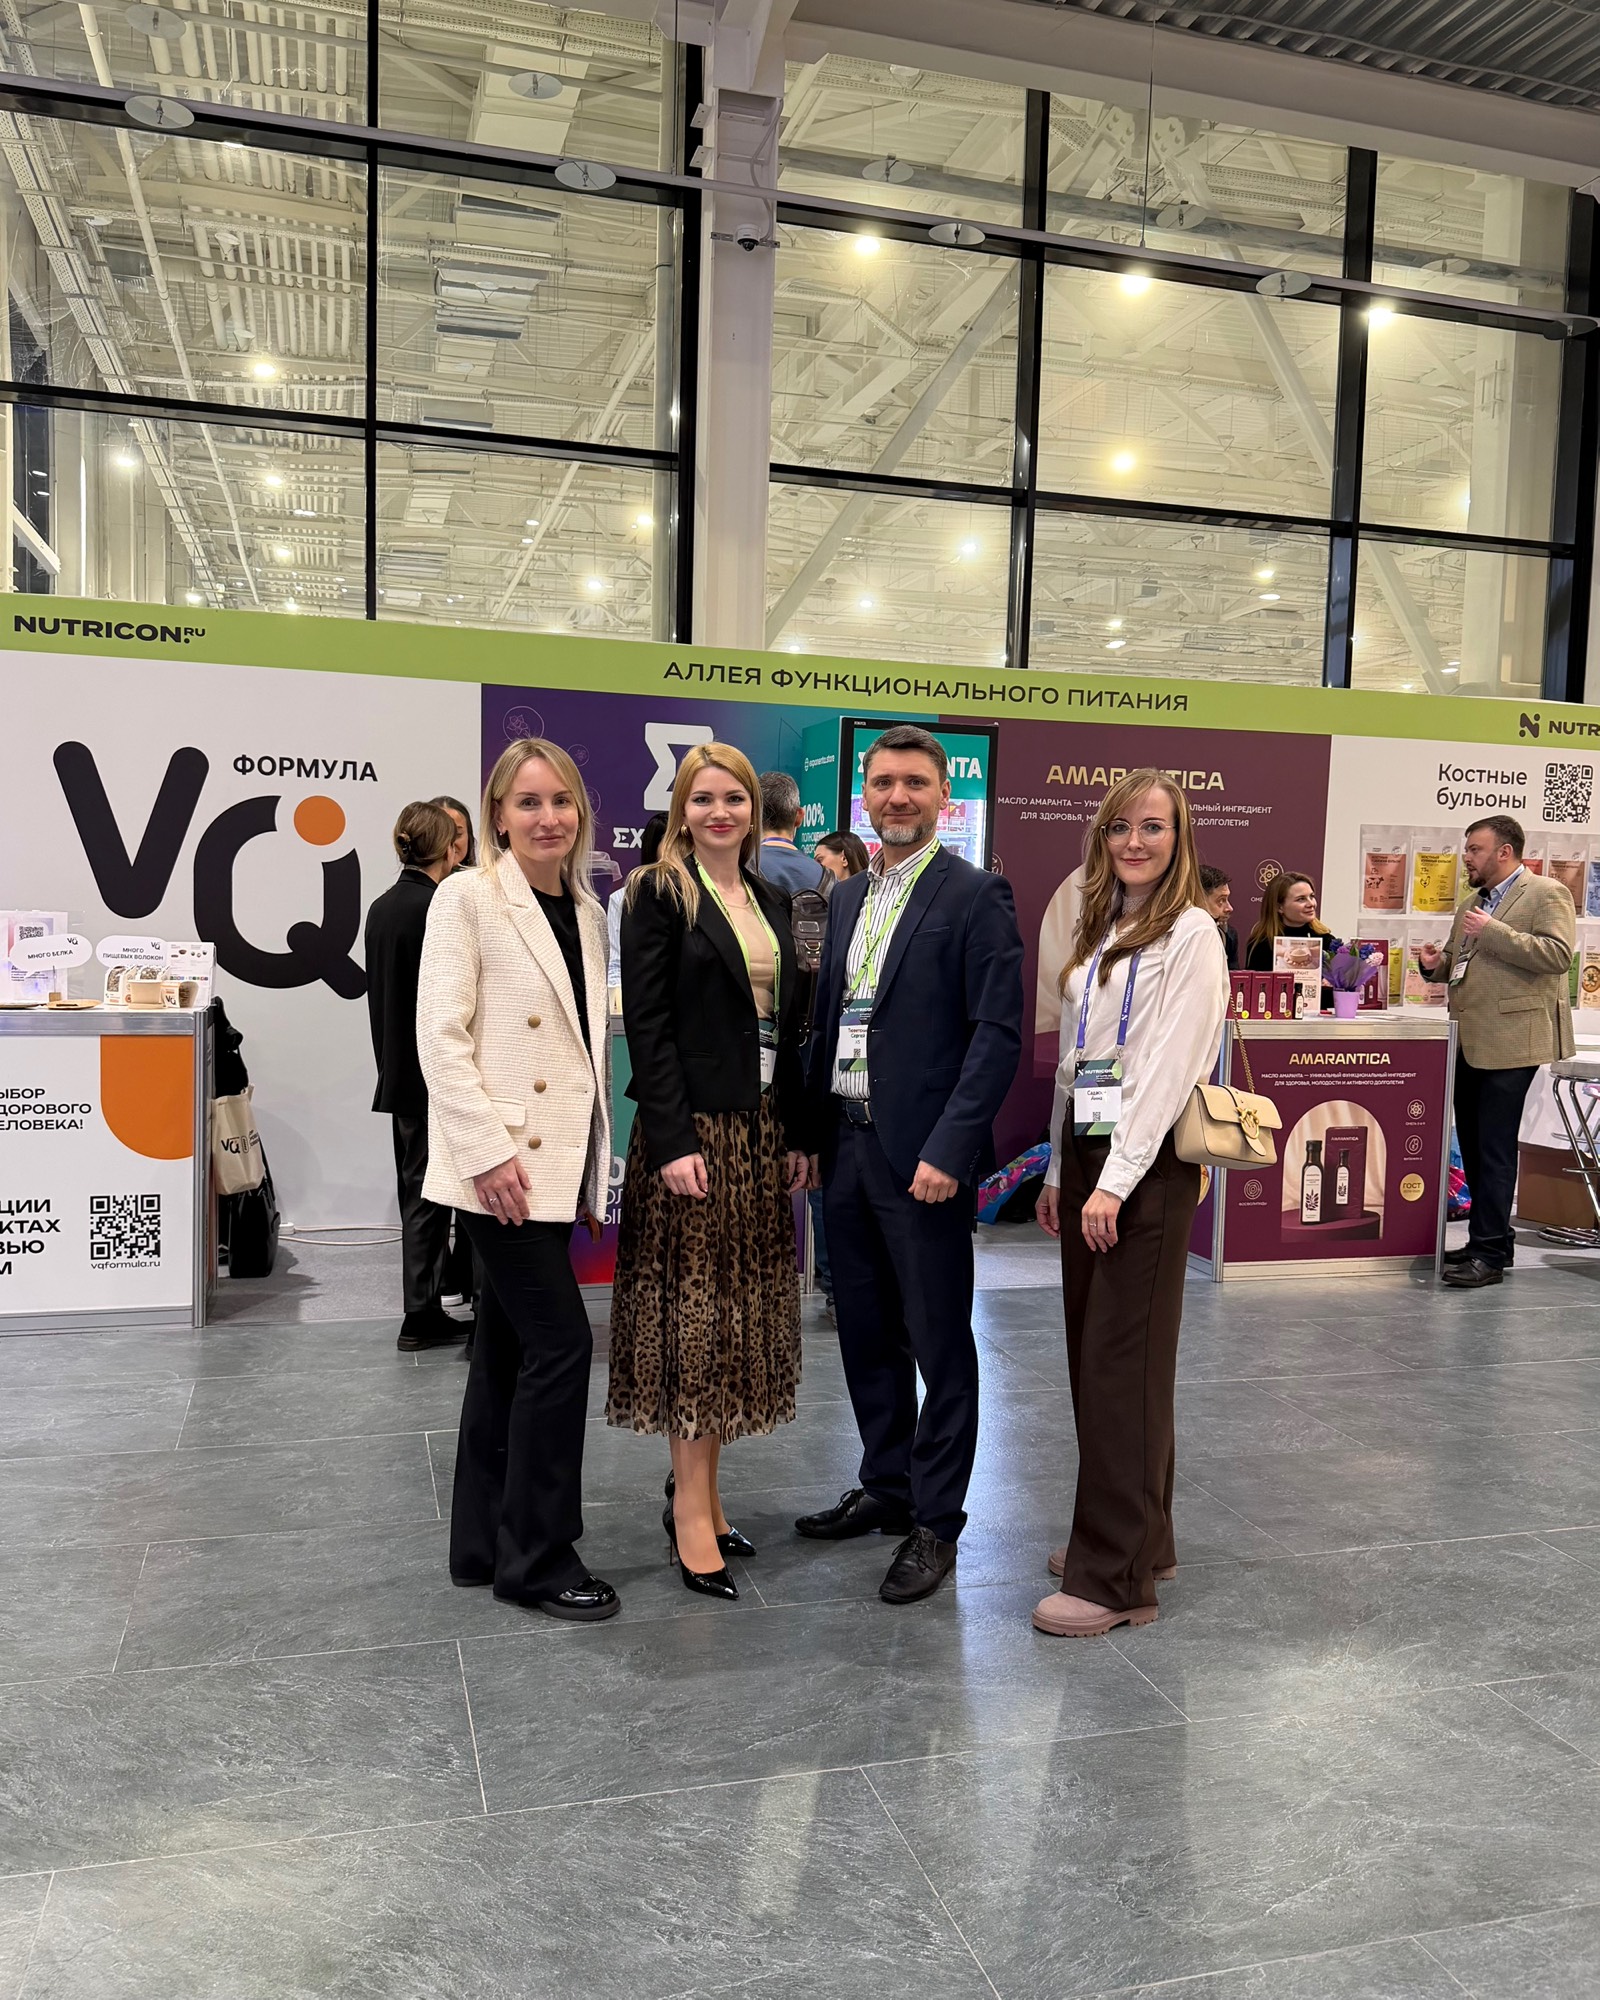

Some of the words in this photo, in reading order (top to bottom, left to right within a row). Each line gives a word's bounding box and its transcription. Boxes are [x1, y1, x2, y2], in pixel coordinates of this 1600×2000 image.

[663, 661, 762, 686] АЛЛЕЯ
[771, 669, 1060, 705] ФУНКЦИОНАЛЬНОГО
[1067, 689, 1189, 712] ПИТАНИЯ
[233, 755, 379, 782] ФОРМУЛА
[1438, 763, 1528, 786] Костные
[997, 796, 1028, 805] МАСЛО
[1030, 798, 1072, 807] АМАРАНТА
[1222, 805, 1273, 814] ИНГРЕДИЕНТ
[1436, 787, 1527, 810] бульоны
[1020, 811, 1038, 820] ДЛЯ
[1039, 812, 1084, 822] ЗДОРОВЬЯ,
[1197, 818, 1250, 827] ДОЛГОЛЕТИЯ
[28, 952, 51, 960] МНОГО
[52, 949, 74, 957] БЕЛКА
[1289, 1053, 1391, 1065] AMARANTICA
[90, 1259, 161, 1270] vqformula.ru
